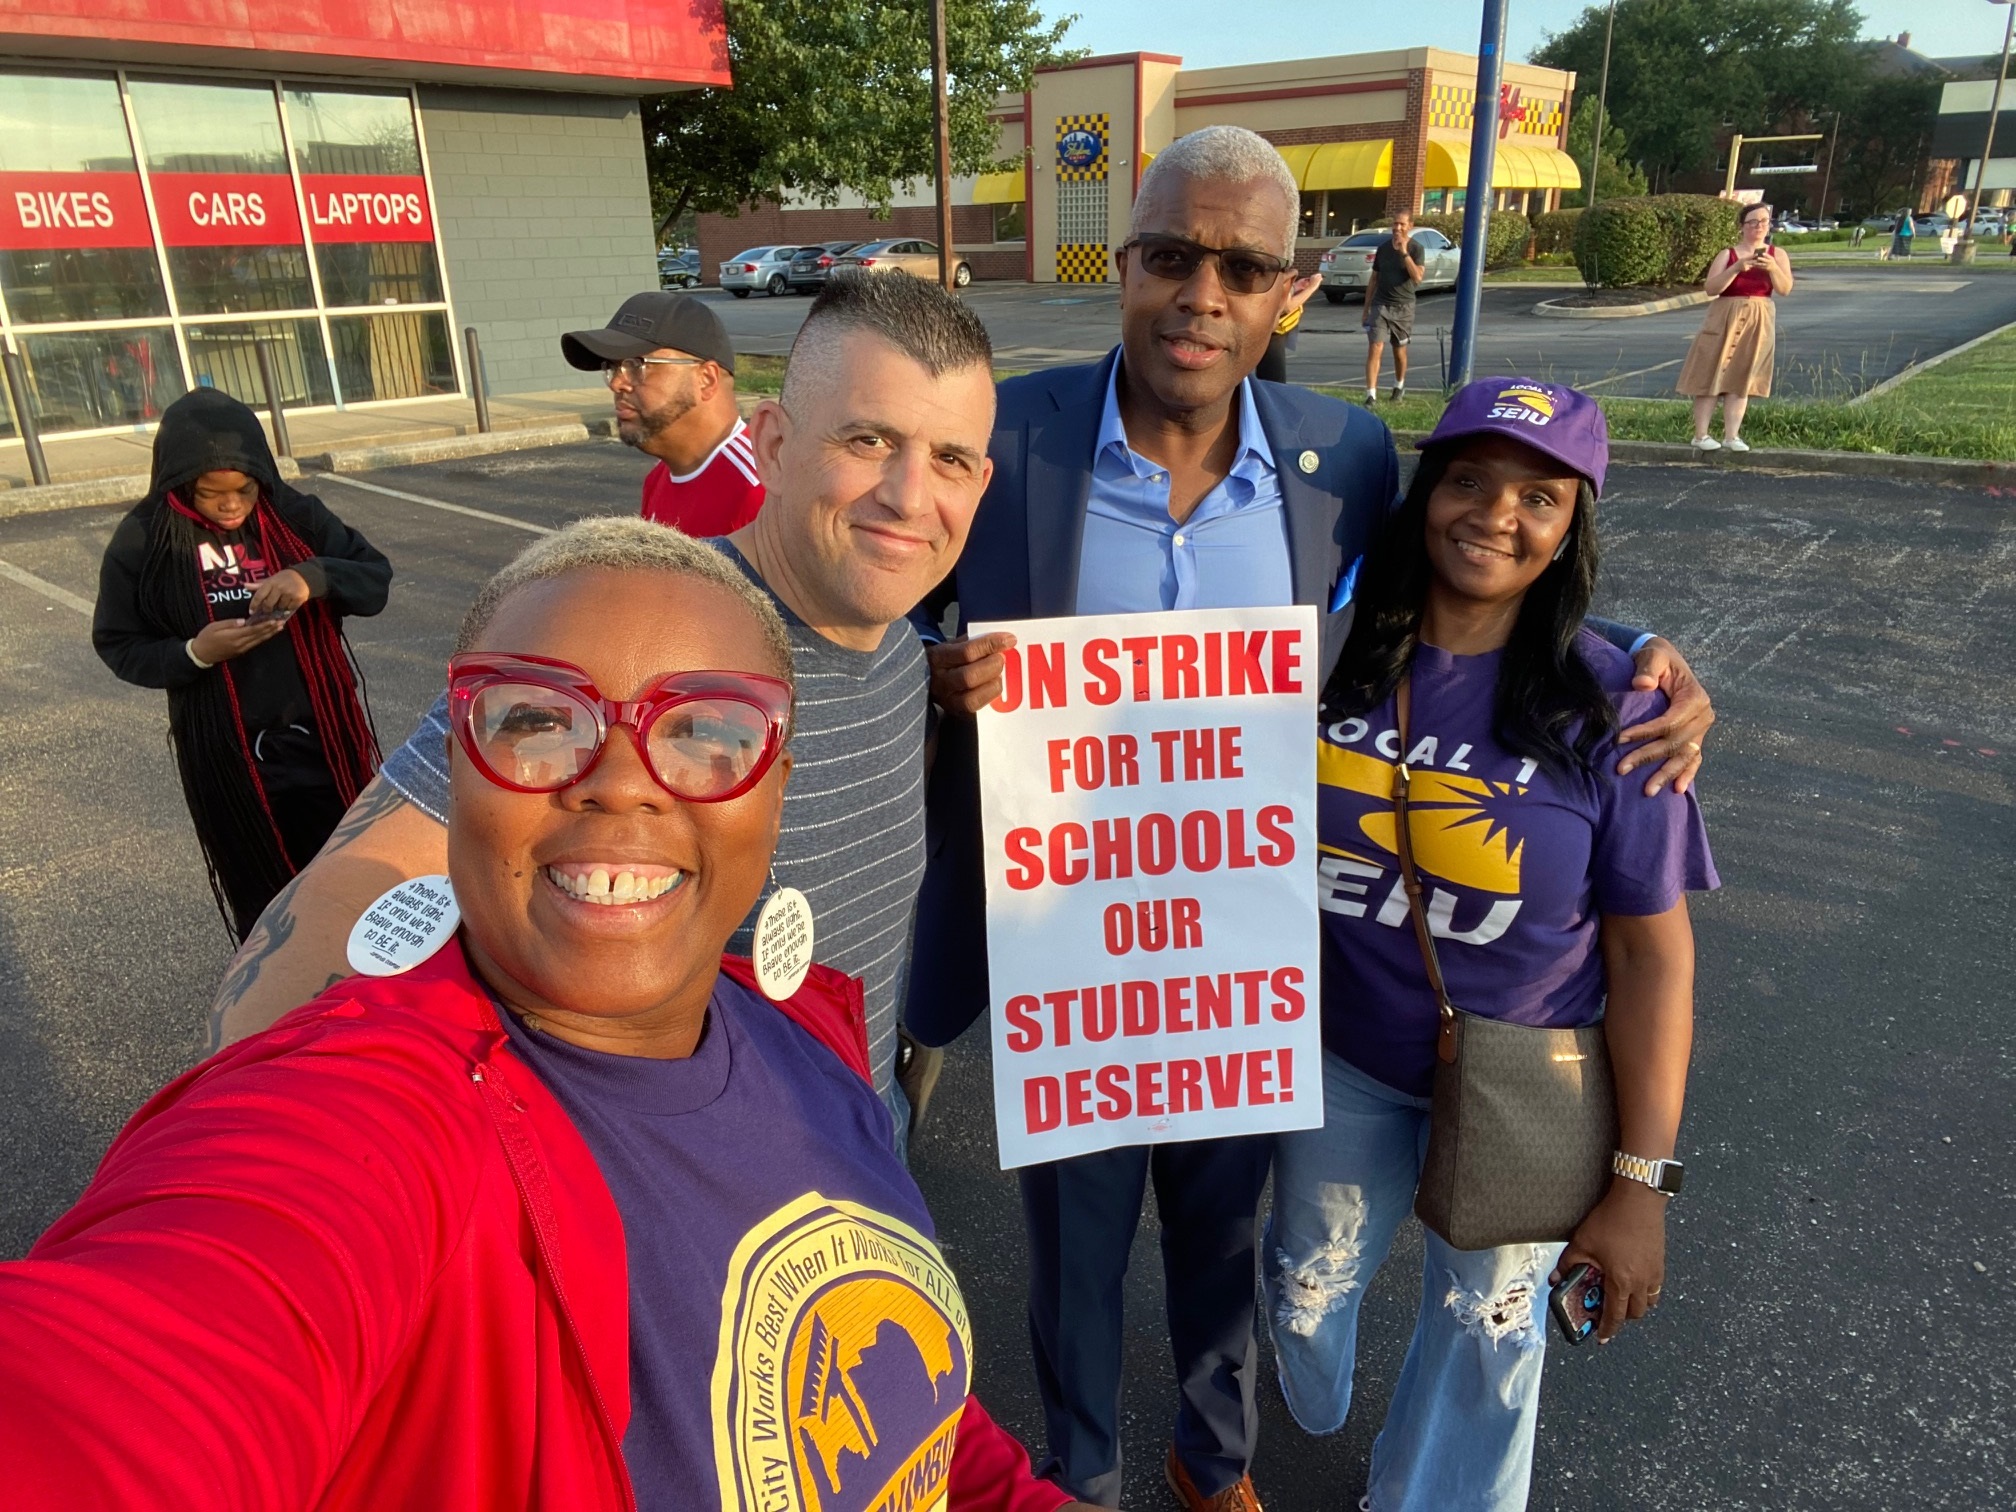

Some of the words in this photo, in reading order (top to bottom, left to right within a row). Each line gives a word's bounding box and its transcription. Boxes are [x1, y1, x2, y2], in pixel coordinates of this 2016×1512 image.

[15, 192, 114, 228] BIKES
[188, 192, 266, 226] CARS
[309, 193, 423, 225] LAPTOPS
[1487, 407, 1550, 425] SEIU
[207, 589, 252, 604] ONUS
[989, 642, 1067, 713] ON
[1082, 630, 1303, 706] STRIKE
[1320, 707, 1473, 771] OCAL
[1047, 733, 1140, 794] FOR
[1151, 726, 1244, 783] THE
[1004, 805, 1296, 890] SCHOOLS
[389, 906, 413, 923] only
[391, 890, 424, 911] always
[421, 904, 444, 922] light.
[436, 894, 448, 906] is
[787, 901, 793, 914] is
[1319, 857, 1523, 945] EIU
[375, 934, 392, 948] BE
[390, 925, 424, 948] enough
[762, 921, 785, 947] always
[1103, 898, 1203, 956] OUR
[771, 935, 786, 954] only
[784, 933, 808, 957] enough
[783, 960, 792, 974] BE
[1005, 966, 1306, 1053] STUDENTS
[1024, 1047, 1294, 1135] DESERVE!
[831, 1234, 848, 1267] It
[849, 1229, 898, 1266] Works
[770, 1249, 828, 1302] When
[897, 1251, 920, 1281] for
[926, 1269, 952, 1312] ALL
[754, 1292, 788, 1352] Best
[956, 1309, 966, 1332] of
[749, 1352, 778, 1442] Works
